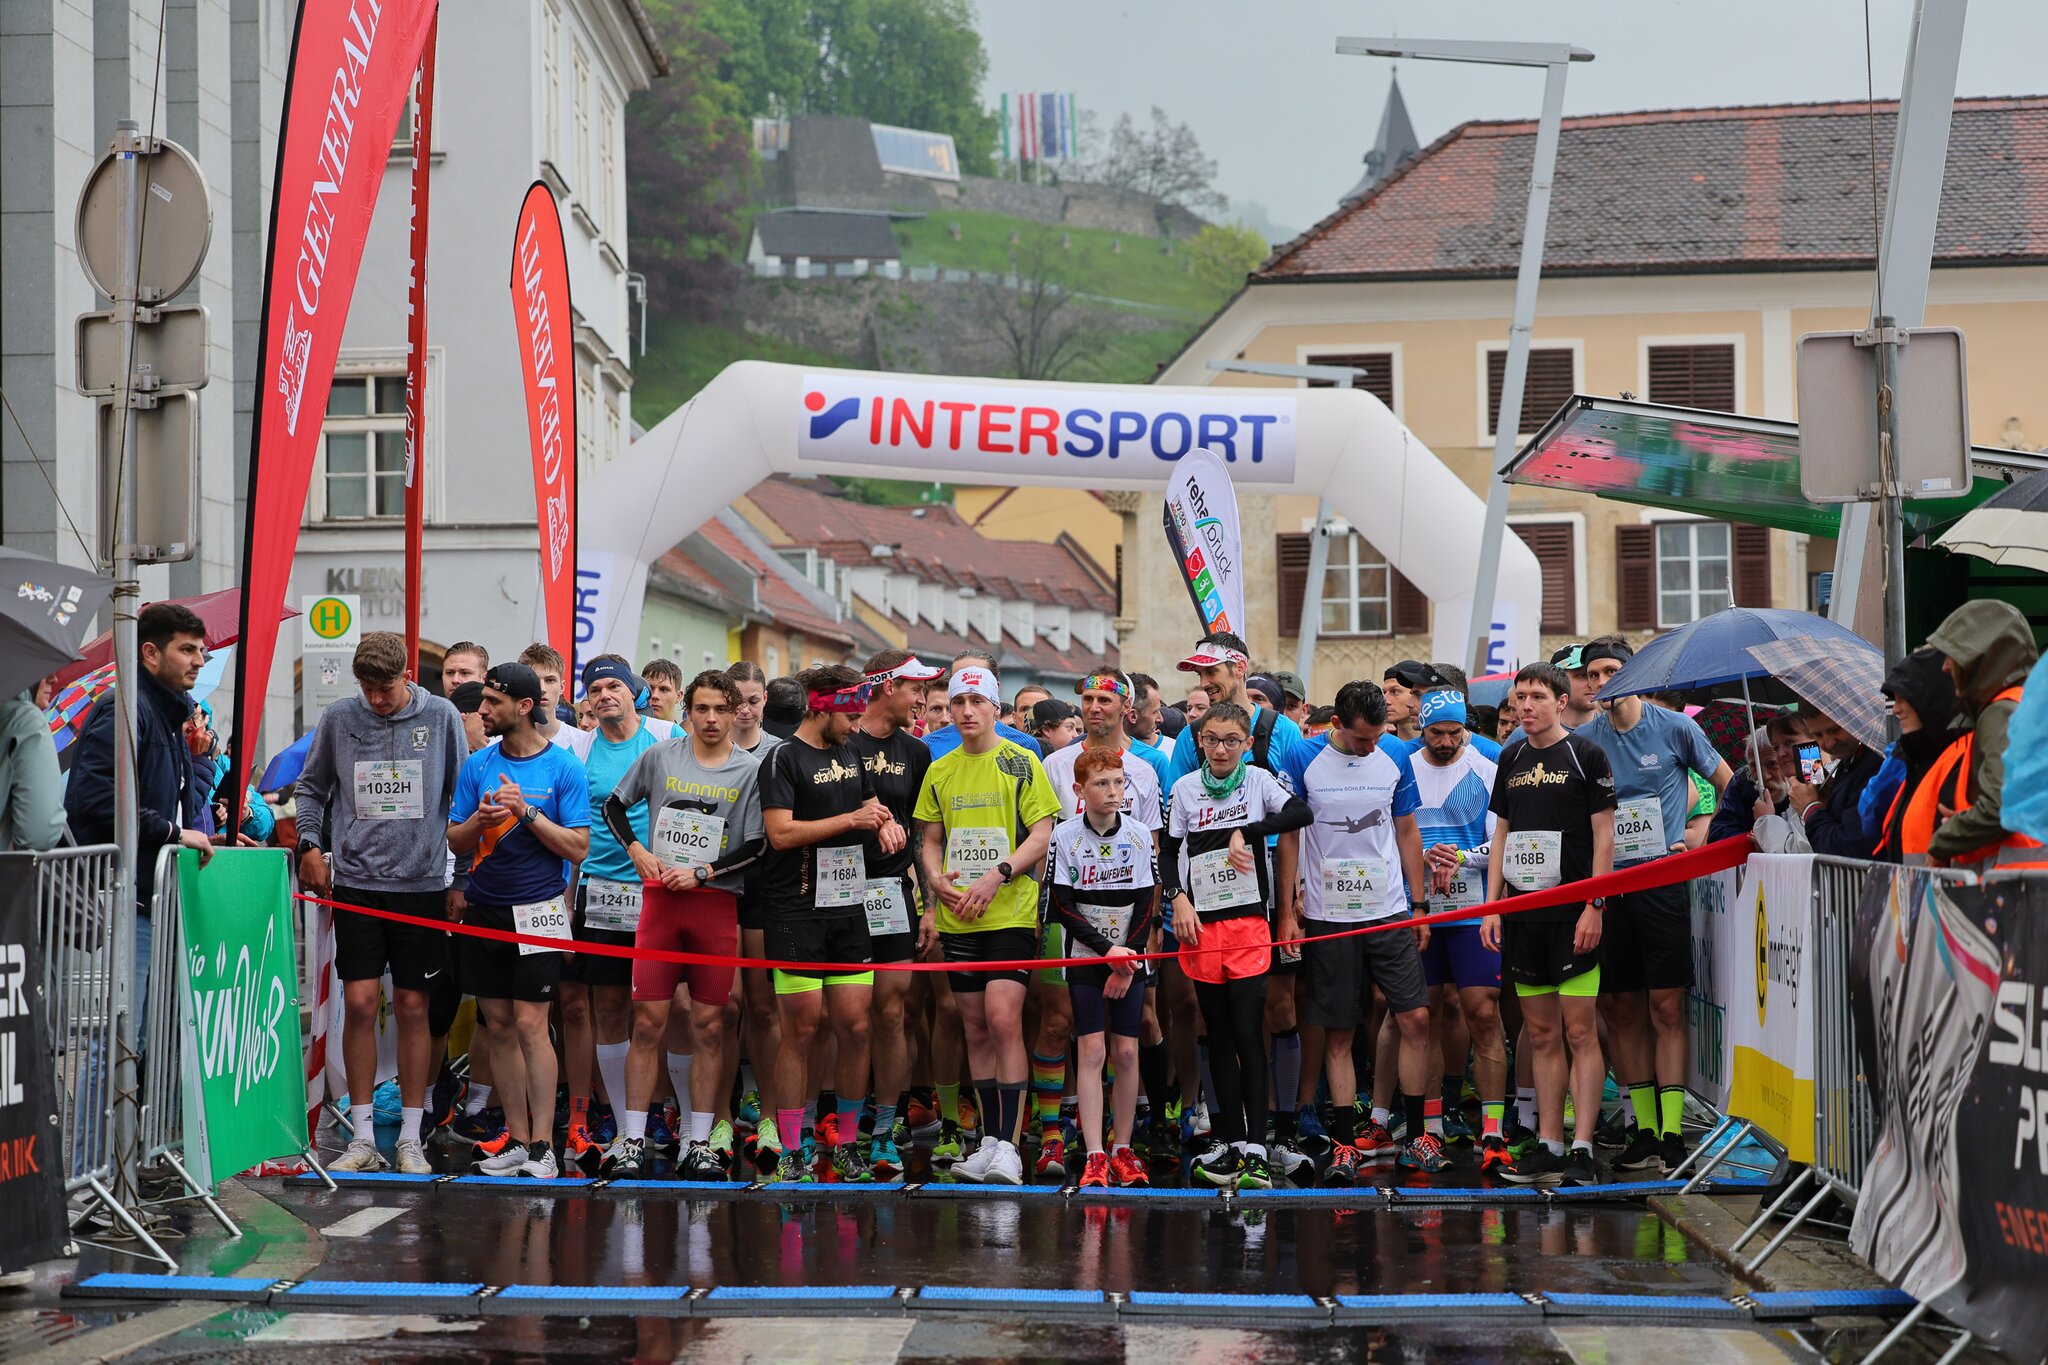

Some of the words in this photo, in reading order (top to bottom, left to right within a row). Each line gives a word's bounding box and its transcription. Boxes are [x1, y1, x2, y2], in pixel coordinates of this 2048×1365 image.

[869, 396, 1278, 463] INTERSPORT
[326, 568, 428, 593] KLEIN
[320, 606, 340, 631] H
[868, 671, 894, 683] PORT
[366, 781, 412, 795] 1032H
[665, 776, 740, 803] Running
[1613, 819, 1653, 836] 028A
[665, 830, 710, 849] 1002C
[957, 849, 999, 861] 1230D
[1514, 852, 1546, 865] 168B
[831, 867, 858, 881] 168A
[1209, 868, 1238, 885] 15B
[1336, 879, 1374, 892] 824A
[600, 893, 635, 907] 1241I
[531, 914, 565, 928] 805C
[1096, 927, 1121, 940] 5C
